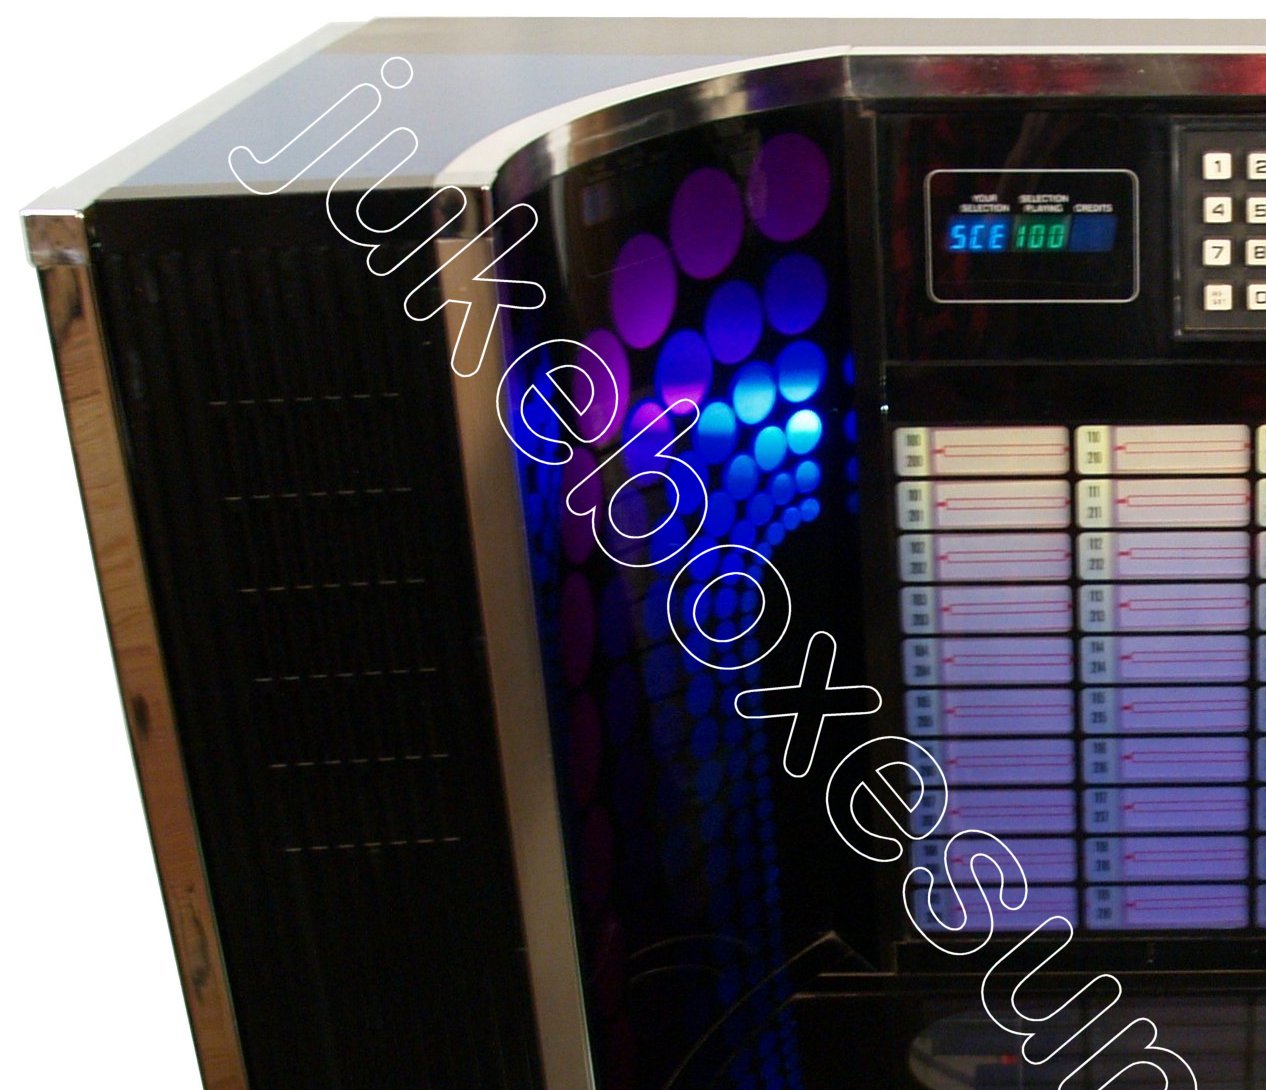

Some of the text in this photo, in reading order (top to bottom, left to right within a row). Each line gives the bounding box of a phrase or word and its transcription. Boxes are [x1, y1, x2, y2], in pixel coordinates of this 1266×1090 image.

[1214, 160, 1222, 173] 1
[1018, 194, 1069, 203] SELECTION
[959, 204, 1010, 213] SELECTION
[1073, 204, 1114, 213] CREDITS
[1212, 203, 1225, 216] 4
[1015, 224, 1066, 249] 100
[1211, 246, 1224, 259] 7
